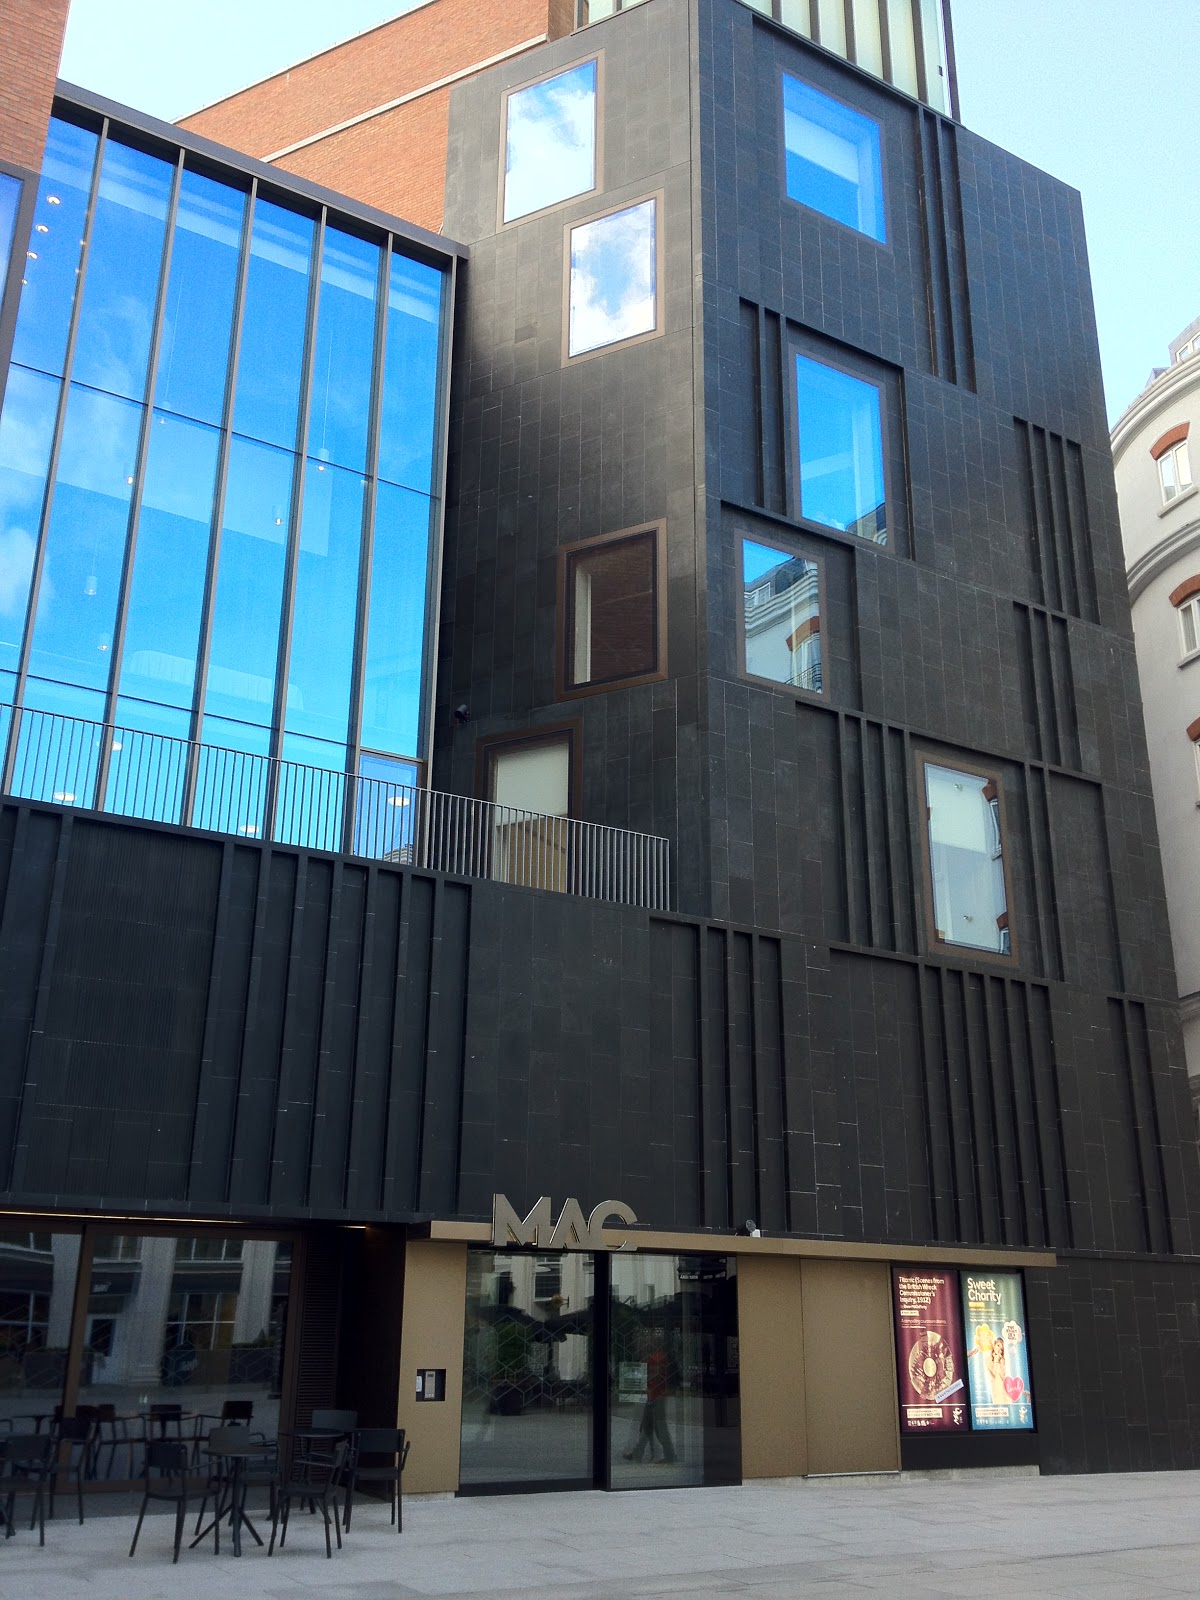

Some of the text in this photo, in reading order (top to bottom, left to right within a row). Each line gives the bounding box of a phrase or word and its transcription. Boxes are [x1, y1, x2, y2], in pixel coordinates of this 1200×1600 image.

[492, 1193, 638, 1251] MAC
[967, 1277, 996, 1290] Sweet
[968, 1289, 1002, 1305] Charity
